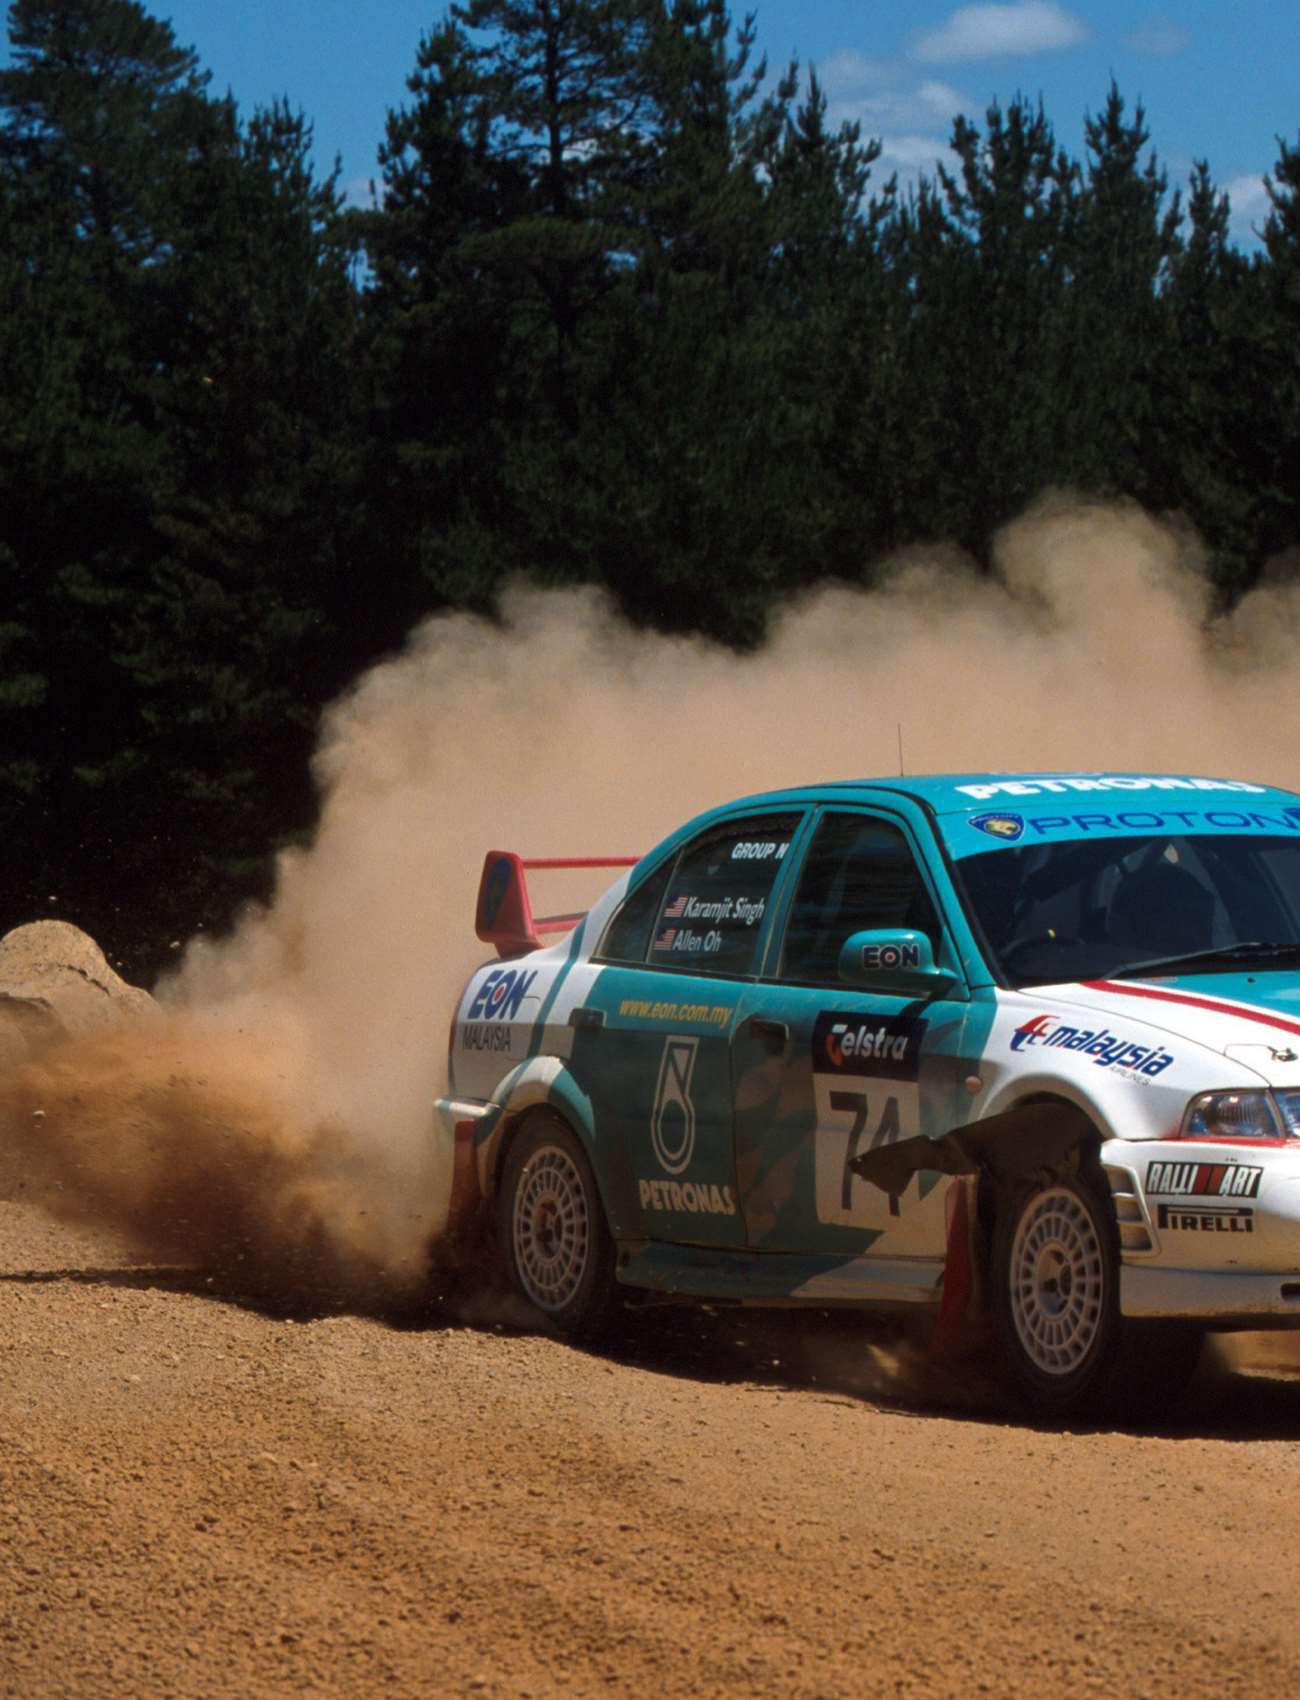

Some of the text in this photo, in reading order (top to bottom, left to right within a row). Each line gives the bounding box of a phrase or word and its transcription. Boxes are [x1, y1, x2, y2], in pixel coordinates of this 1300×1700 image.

[955, 777, 1266, 799] PETRONAS
[1027, 811, 1300, 834] PROTON
[731, 842, 789, 860] GROUP N
[683, 896, 765, 925] Karamjit Singh
[672, 929, 721, 952] Allen Oh
[862, 943, 919, 969] EON
[468, 970, 538, 1020] EON
[619, 1000, 732, 1028] www.eon.com.my
[463, 1027, 512, 1051] MALAYSIA
[826, 1024, 908, 1067] Telstra
[1043, 1026, 1175, 1077] malaysia
[638, 1178, 737, 1216] PETRONAS
[1157, 1204, 1254, 1233] PIRELLI
